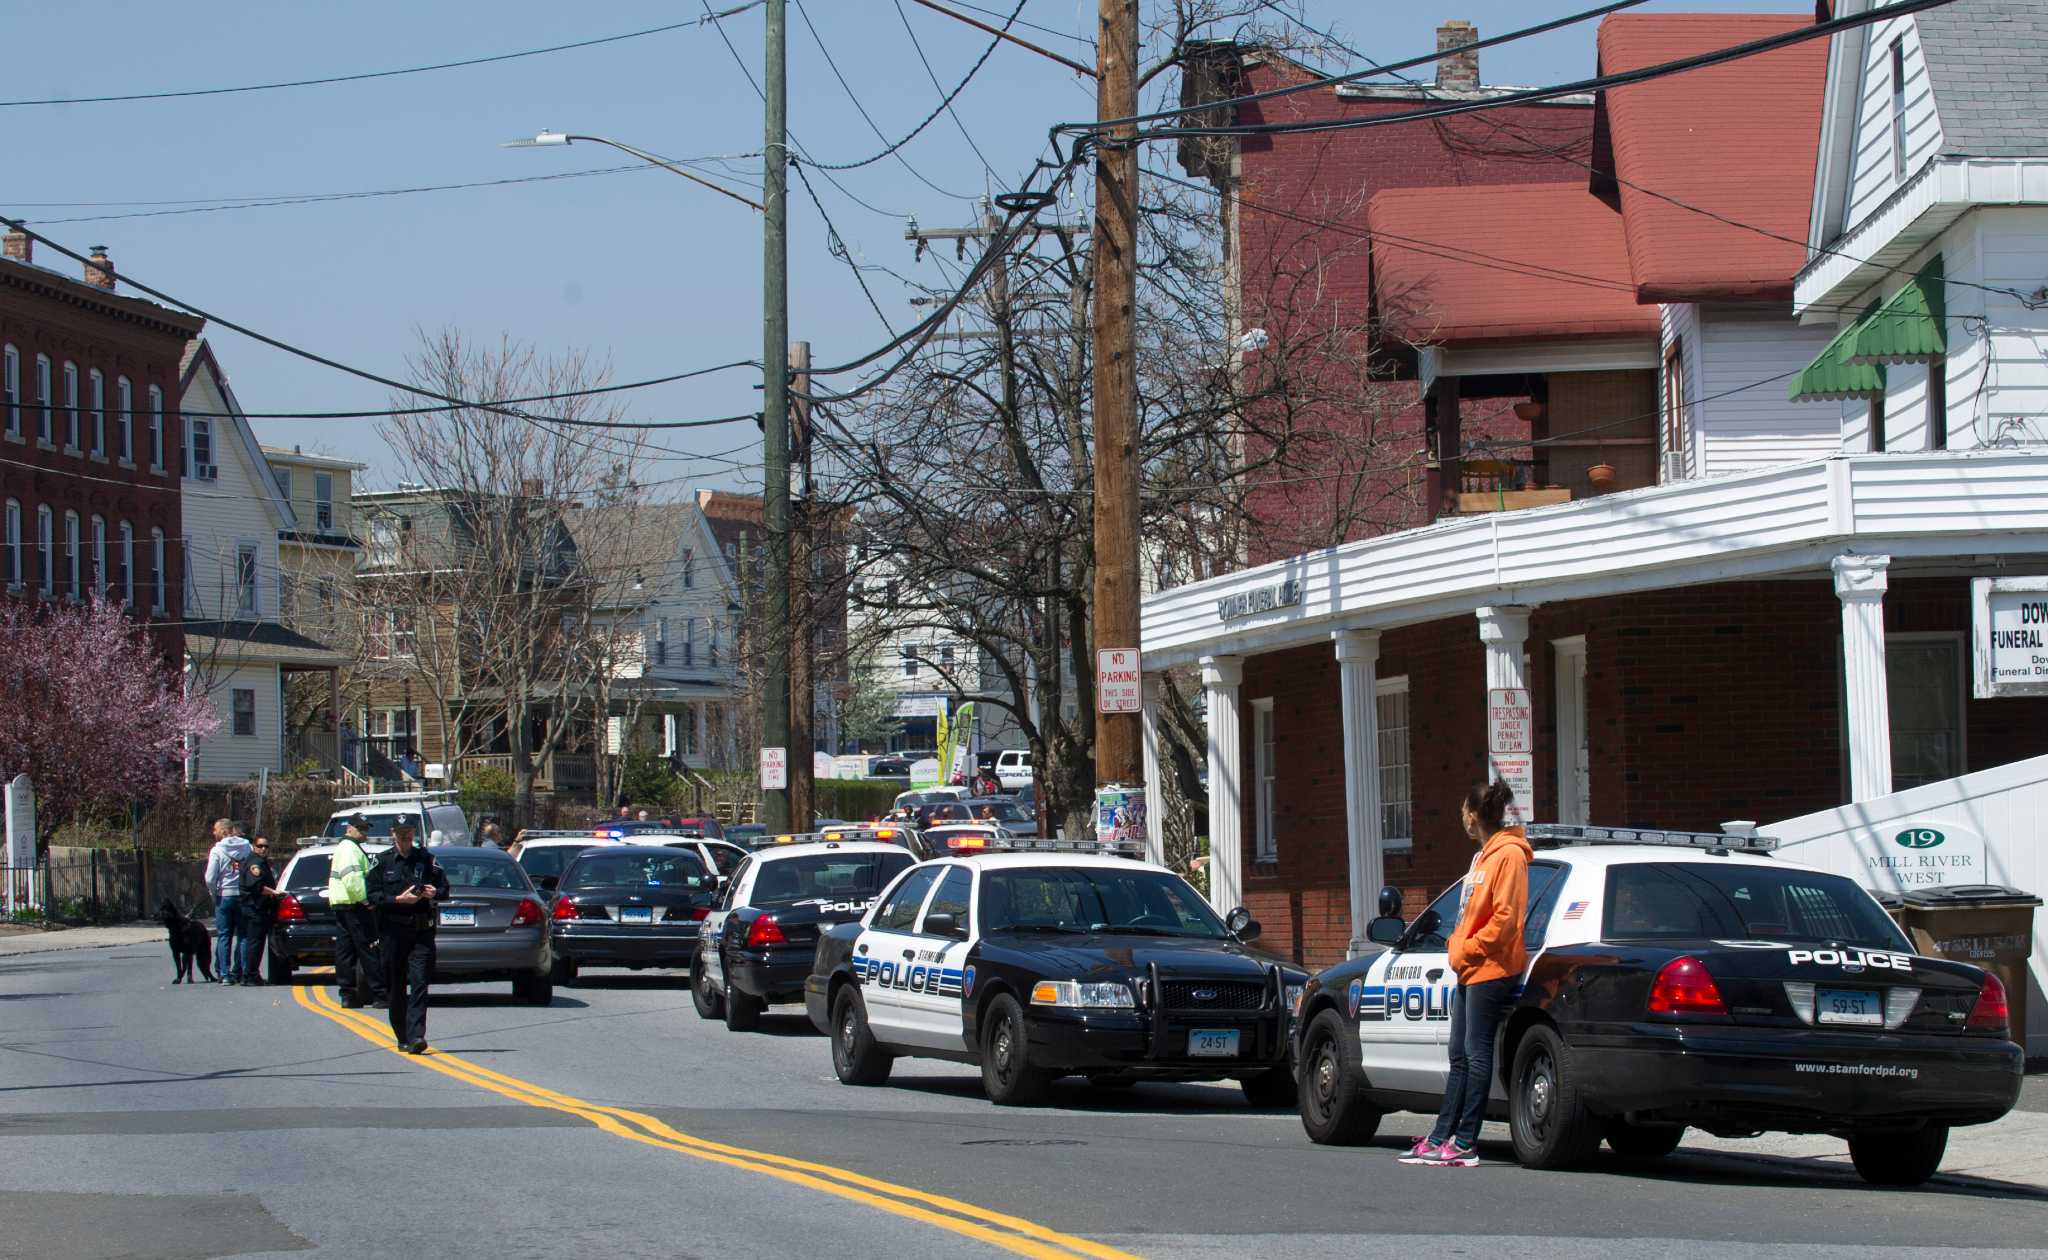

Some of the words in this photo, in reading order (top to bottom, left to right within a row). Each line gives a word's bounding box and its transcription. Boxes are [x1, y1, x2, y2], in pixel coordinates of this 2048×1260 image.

[1991, 630, 2043, 649] FUNERAL
[1112, 653, 1125, 664] NO
[1102, 671, 1137, 682] PARKING
[1992, 667, 2031, 677] Funeral
[1105, 689, 1118, 697] THIS
[1122, 688, 1135, 697] SIDE
[1504, 692, 1516, 705] NO
[1116, 699, 1137, 708] STREET
[1492, 707, 1529, 720] TRESPASSING
[1500, 721, 1521, 730] UNDER
[1497, 731, 1523, 740] PENALTY
[1500, 741, 1507, 750] OF
[1509, 741, 1522, 750] LAW
[768, 751, 778, 760] NO
[1908, 830, 1937, 847] 19
[1869, 856, 1913, 868] MILL
[1919, 855, 1973, 867] RIVER
[1897, 871, 1945, 884] WEST
[820, 901, 876, 913] POLIC
[1788, 950, 1913, 971] POLICE
[865, 958, 942, 996] POLICE
[1388, 965, 1423, 980] STAMFORD
[1385, 984, 1456, 1022] POLI
[1795, 1063, 1919, 1079] www.stamfordpd.org
